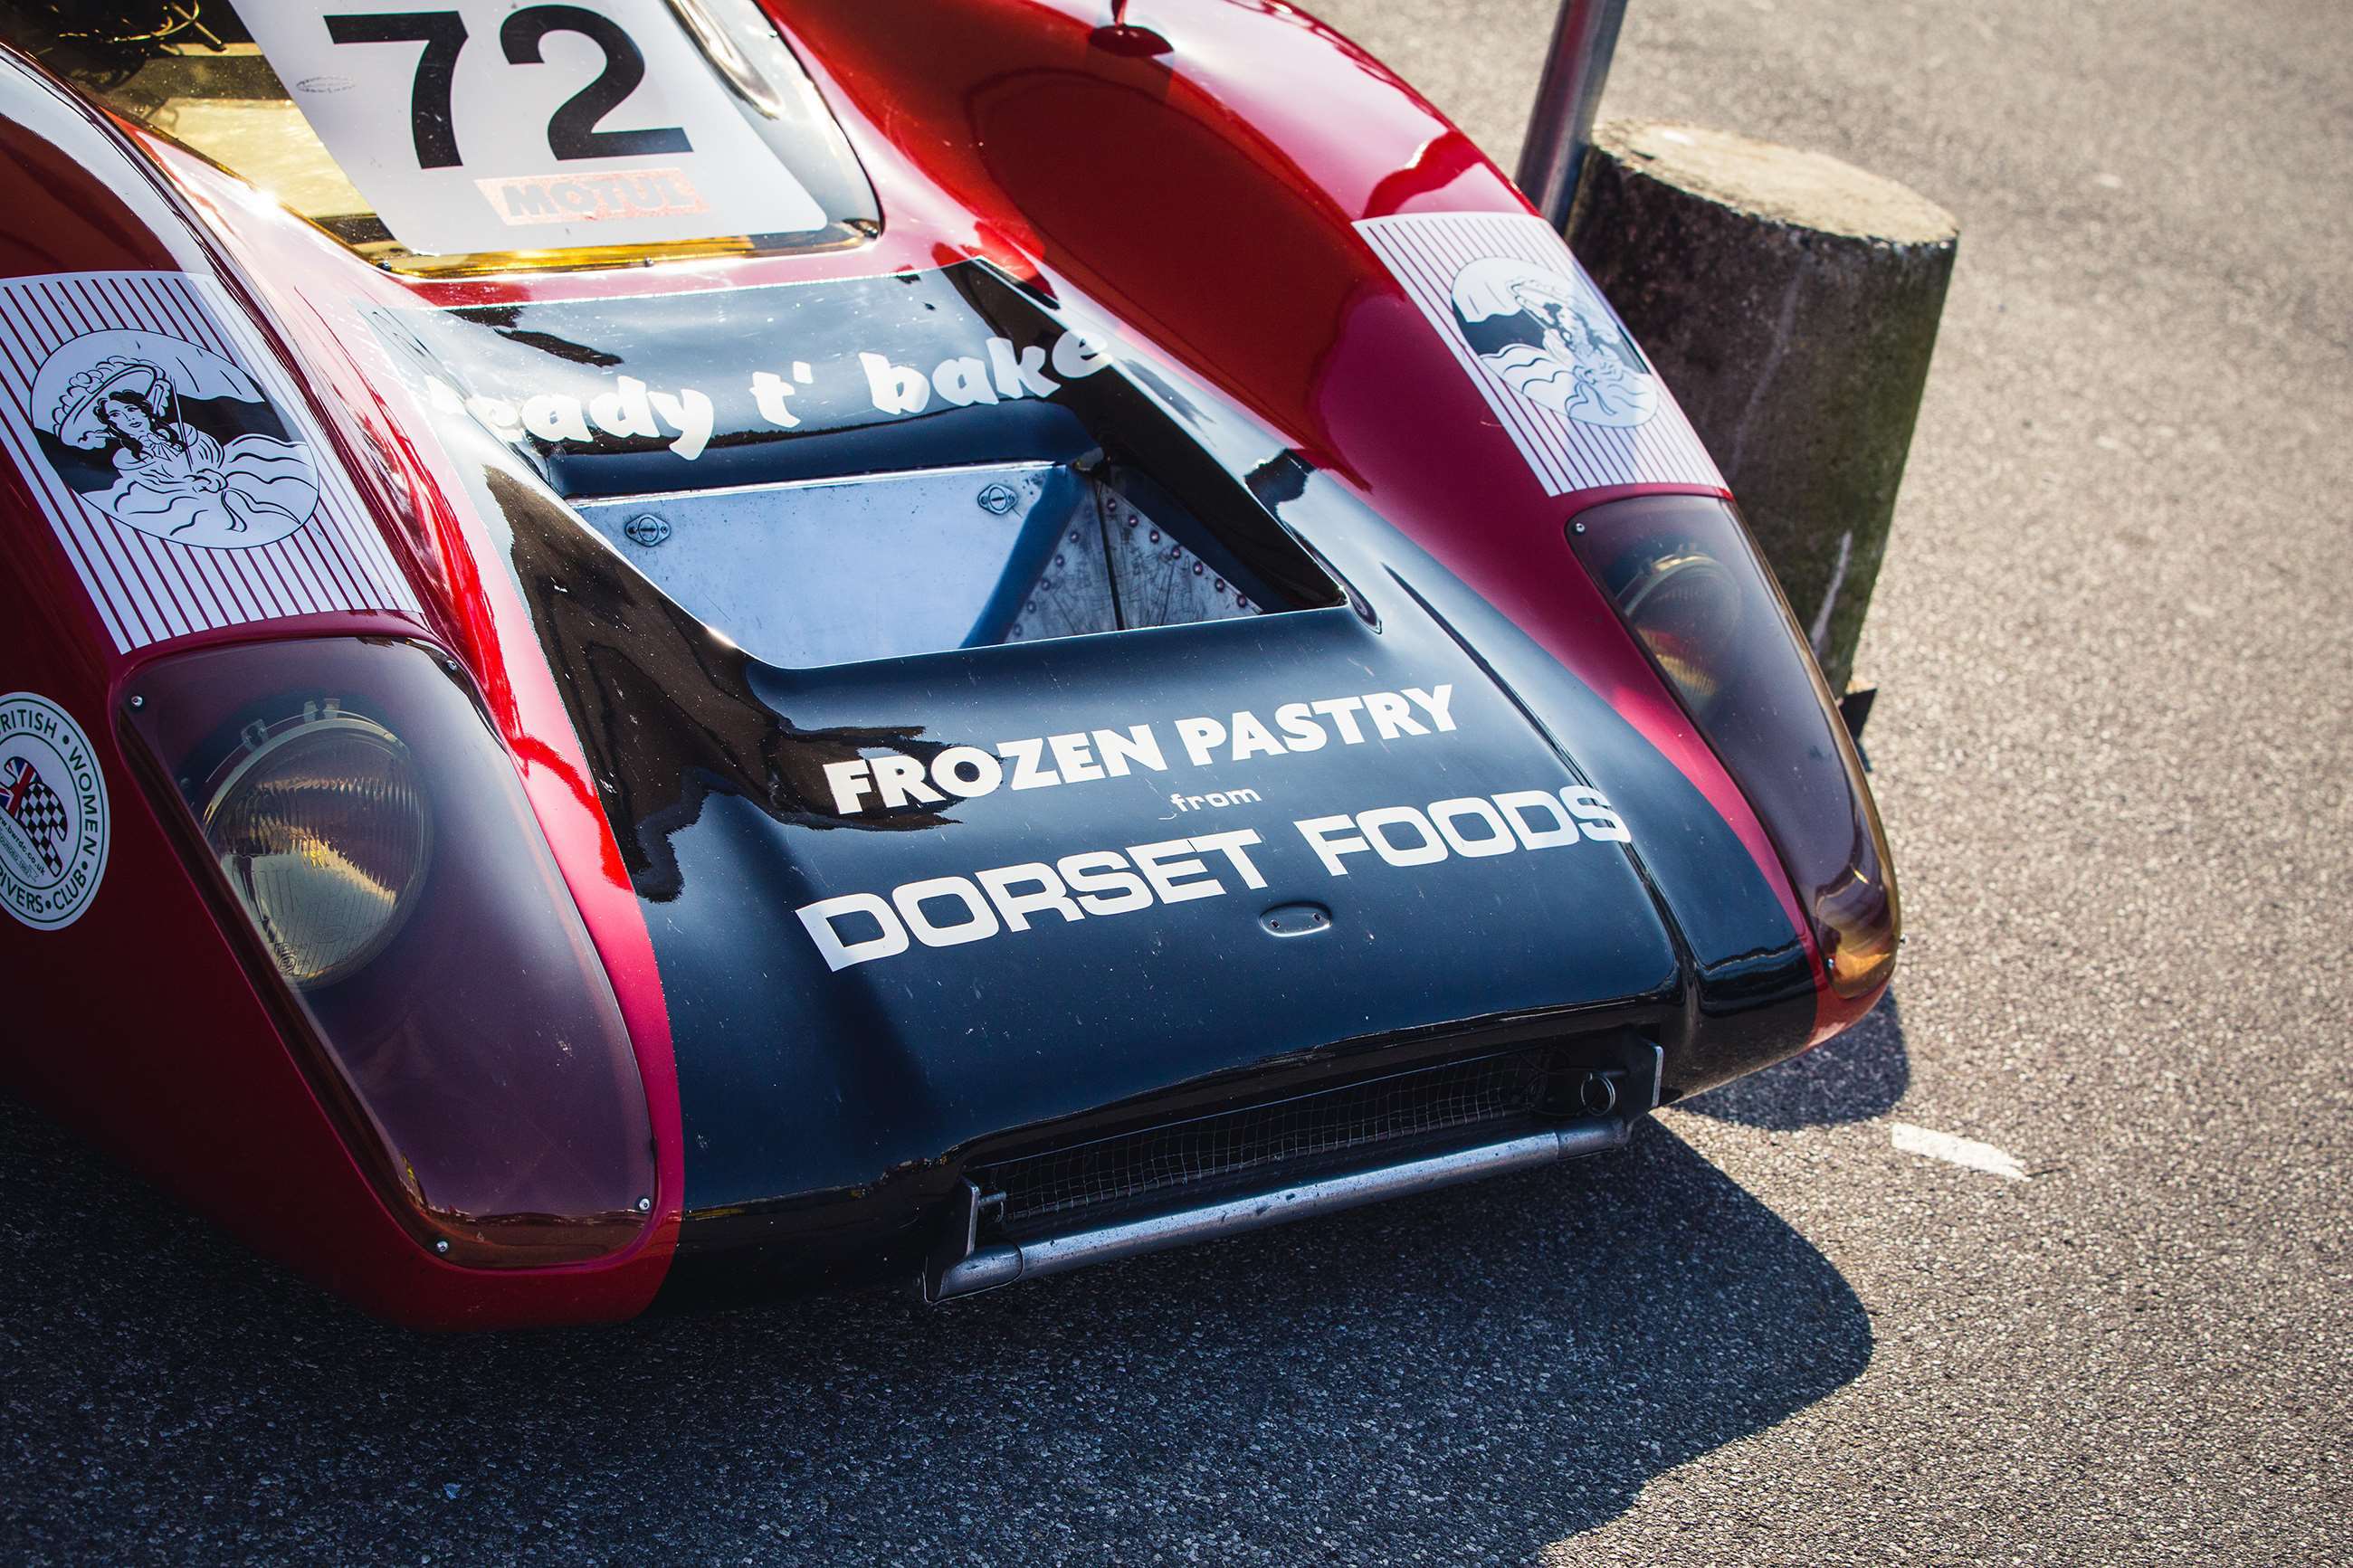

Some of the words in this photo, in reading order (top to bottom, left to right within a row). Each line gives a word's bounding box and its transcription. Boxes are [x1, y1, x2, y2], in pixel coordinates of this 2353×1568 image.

[323, 5, 694, 169] 72
[500, 176, 697, 217] MOTUL
[860, 329, 1112, 416] bake
[0, 708, 58, 739] RITISH
[69, 746, 98, 857] WOMEN
[822, 724, 1168, 815] FROZEN
[1176, 685, 1453, 767] PASTRY
[1170, 788, 1262, 812] from
[0, 865, 44, 914] IVERS
[52, 869, 87, 910] CLUB
[796, 828, 1269, 973] DORSET
[1293, 785, 1632, 876] FOODS
